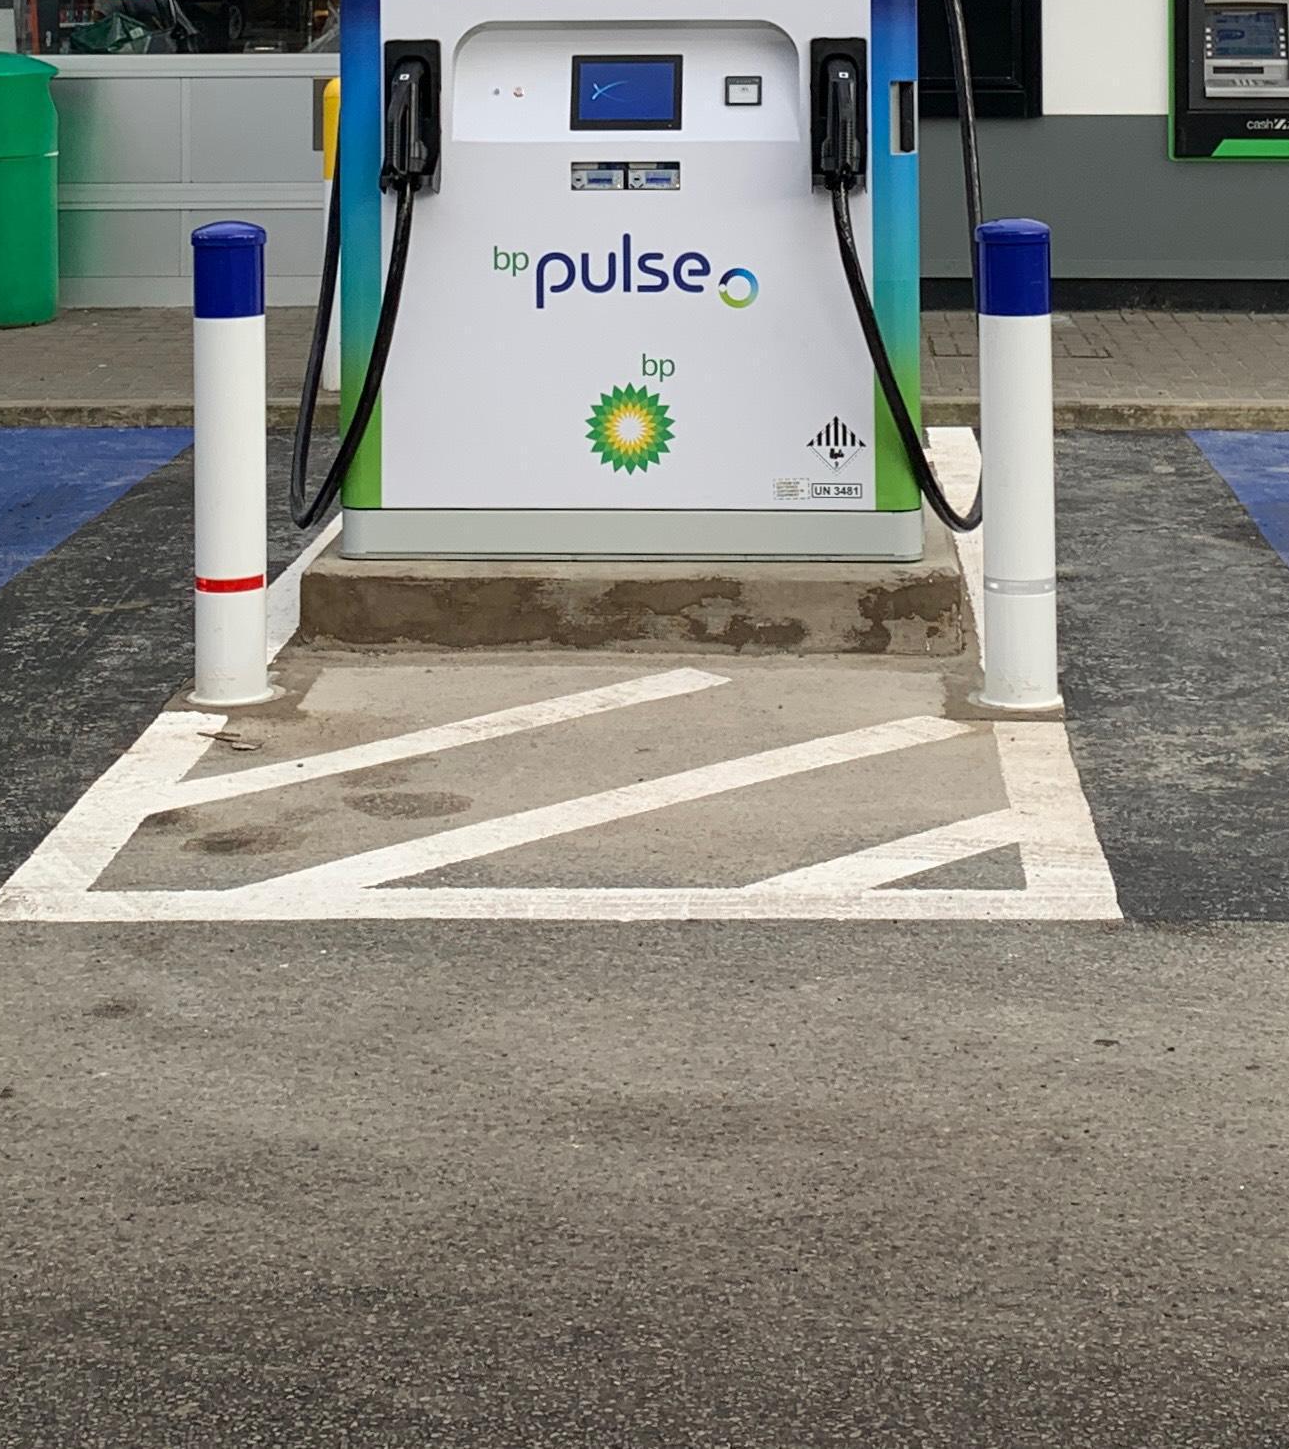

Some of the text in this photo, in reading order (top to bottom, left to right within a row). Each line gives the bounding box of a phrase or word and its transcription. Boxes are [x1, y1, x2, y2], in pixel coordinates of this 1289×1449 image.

[493, 233, 711, 309] bp pulse
[642, 353, 676, 382] bp
[814, 486, 831, 496] UN
[833, 486, 859, 496] 3481
